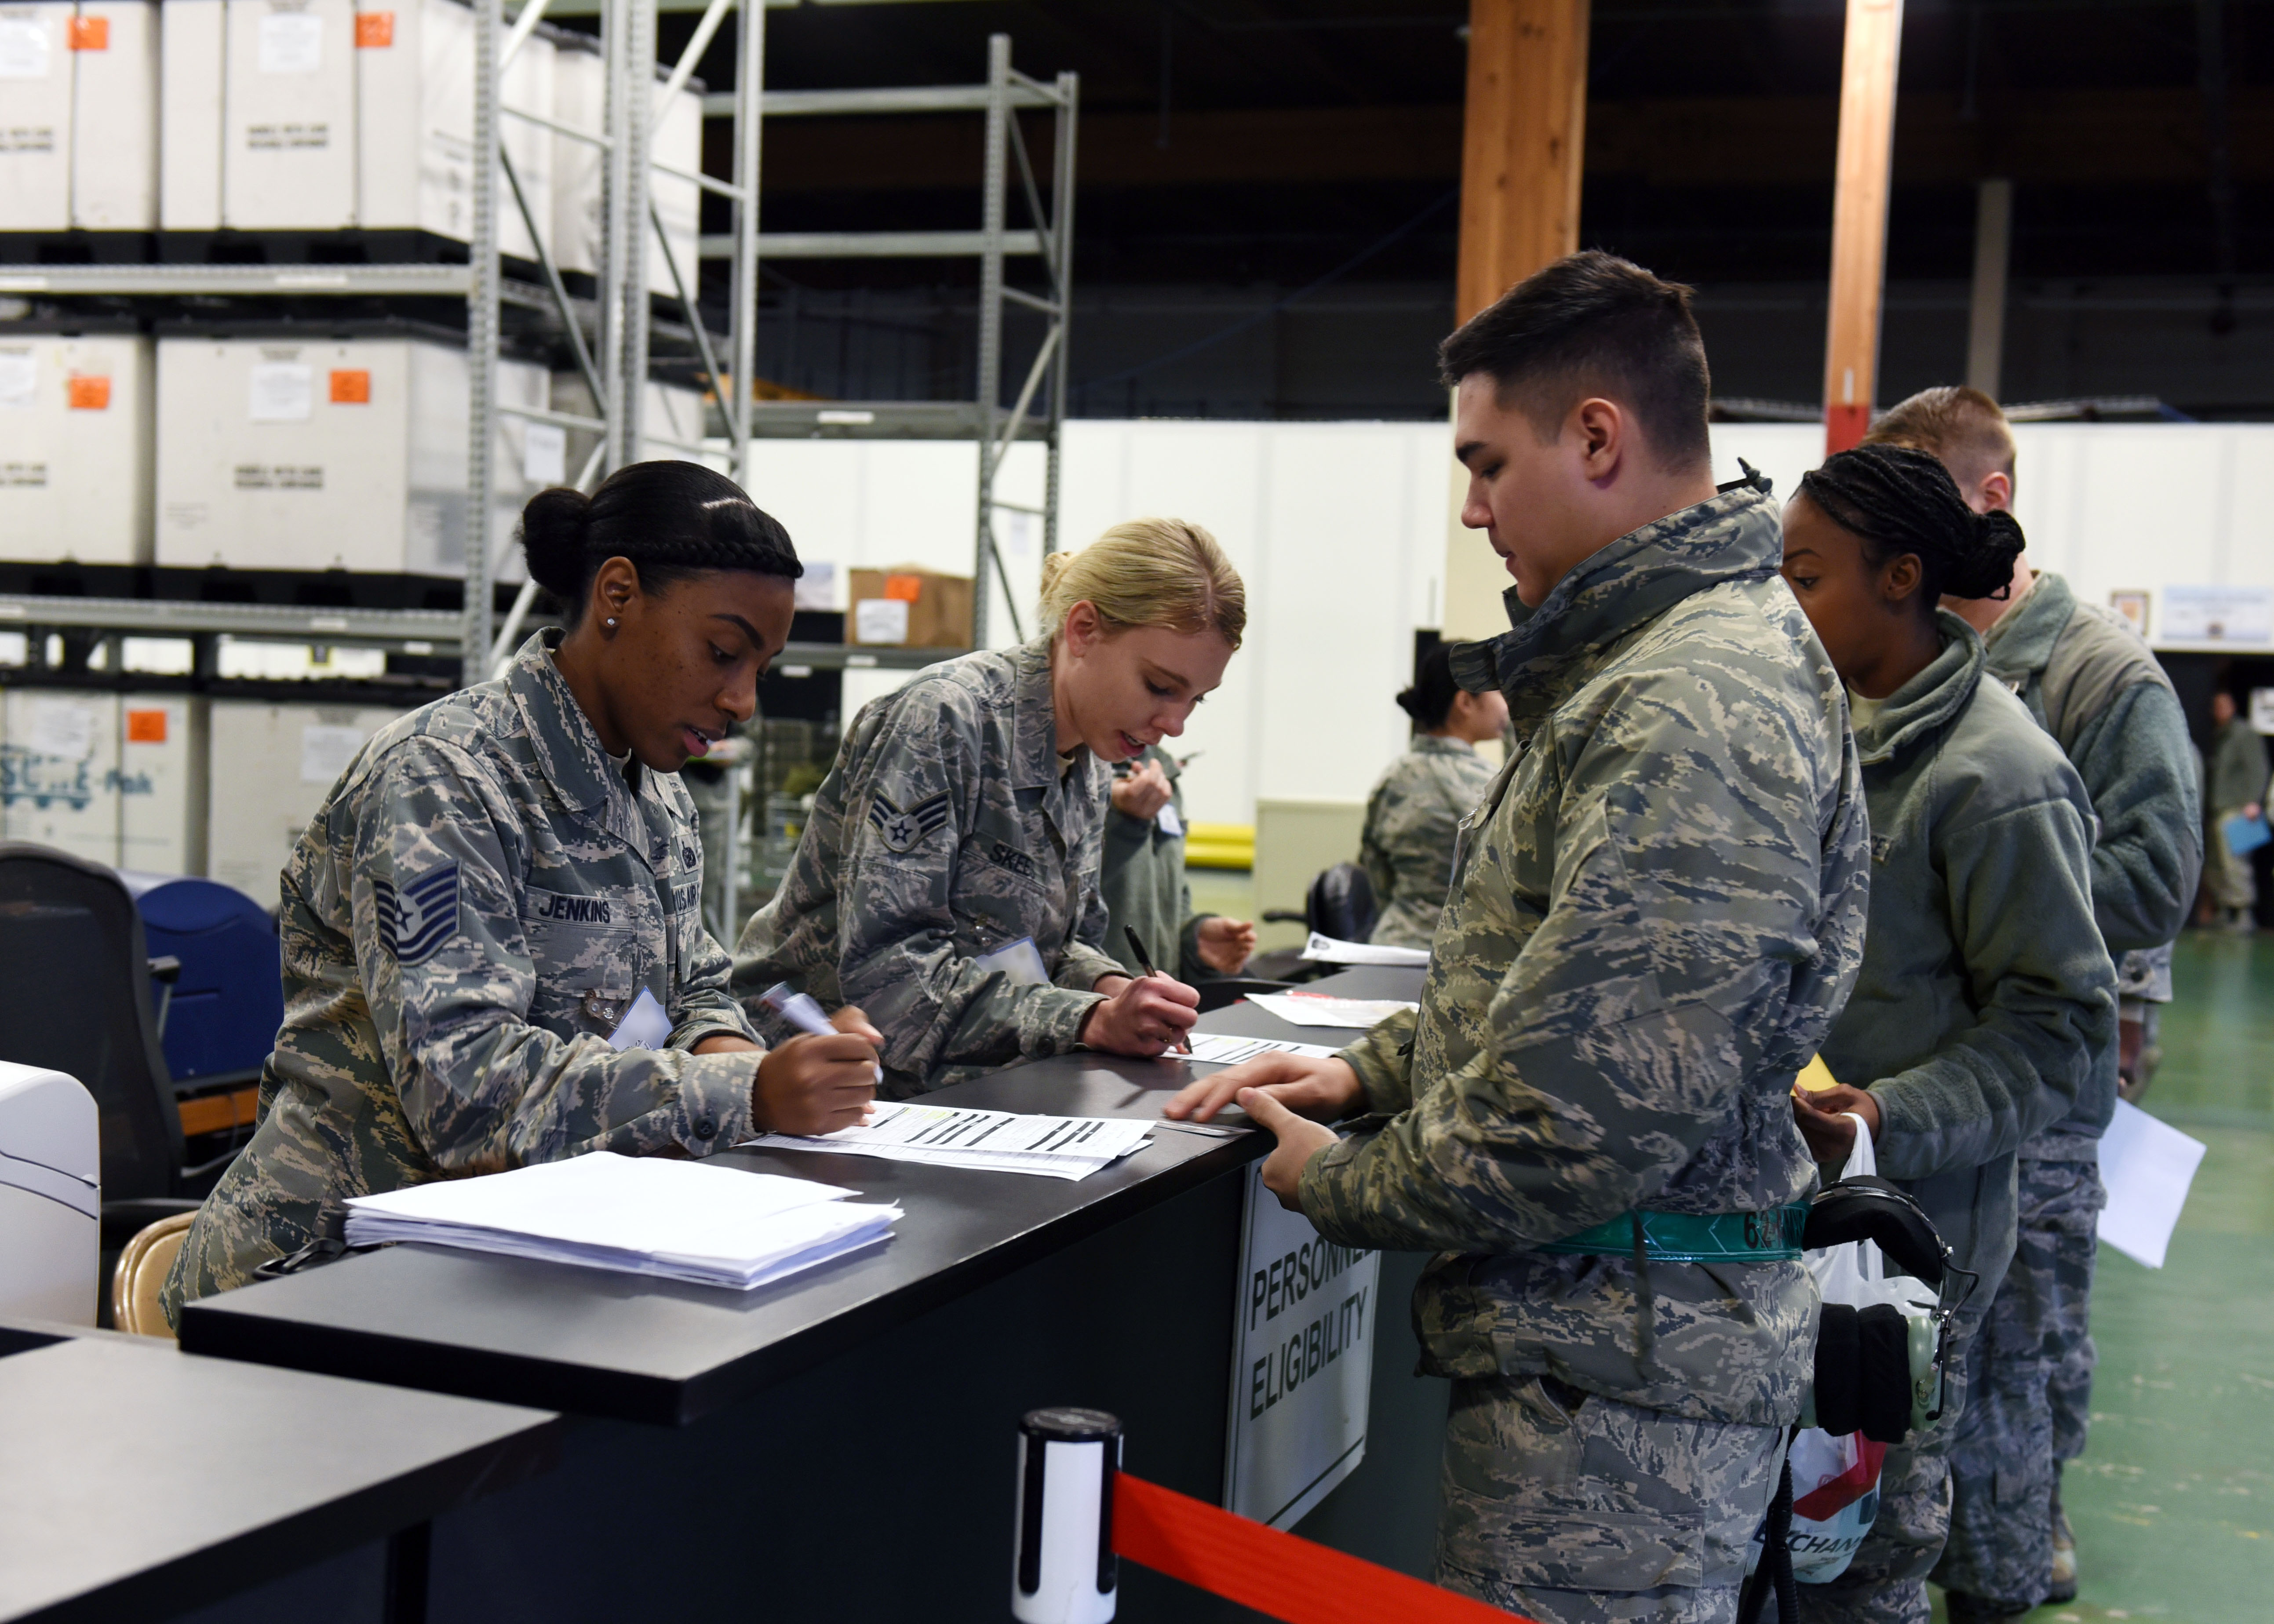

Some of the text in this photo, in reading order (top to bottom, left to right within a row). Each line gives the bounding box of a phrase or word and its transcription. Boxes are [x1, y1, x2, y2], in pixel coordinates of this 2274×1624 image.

[539, 895, 610, 924] JENKINS
[687, 885, 696, 908] AIR
[1250, 1286, 1368, 1421] ELIGIBILITY
